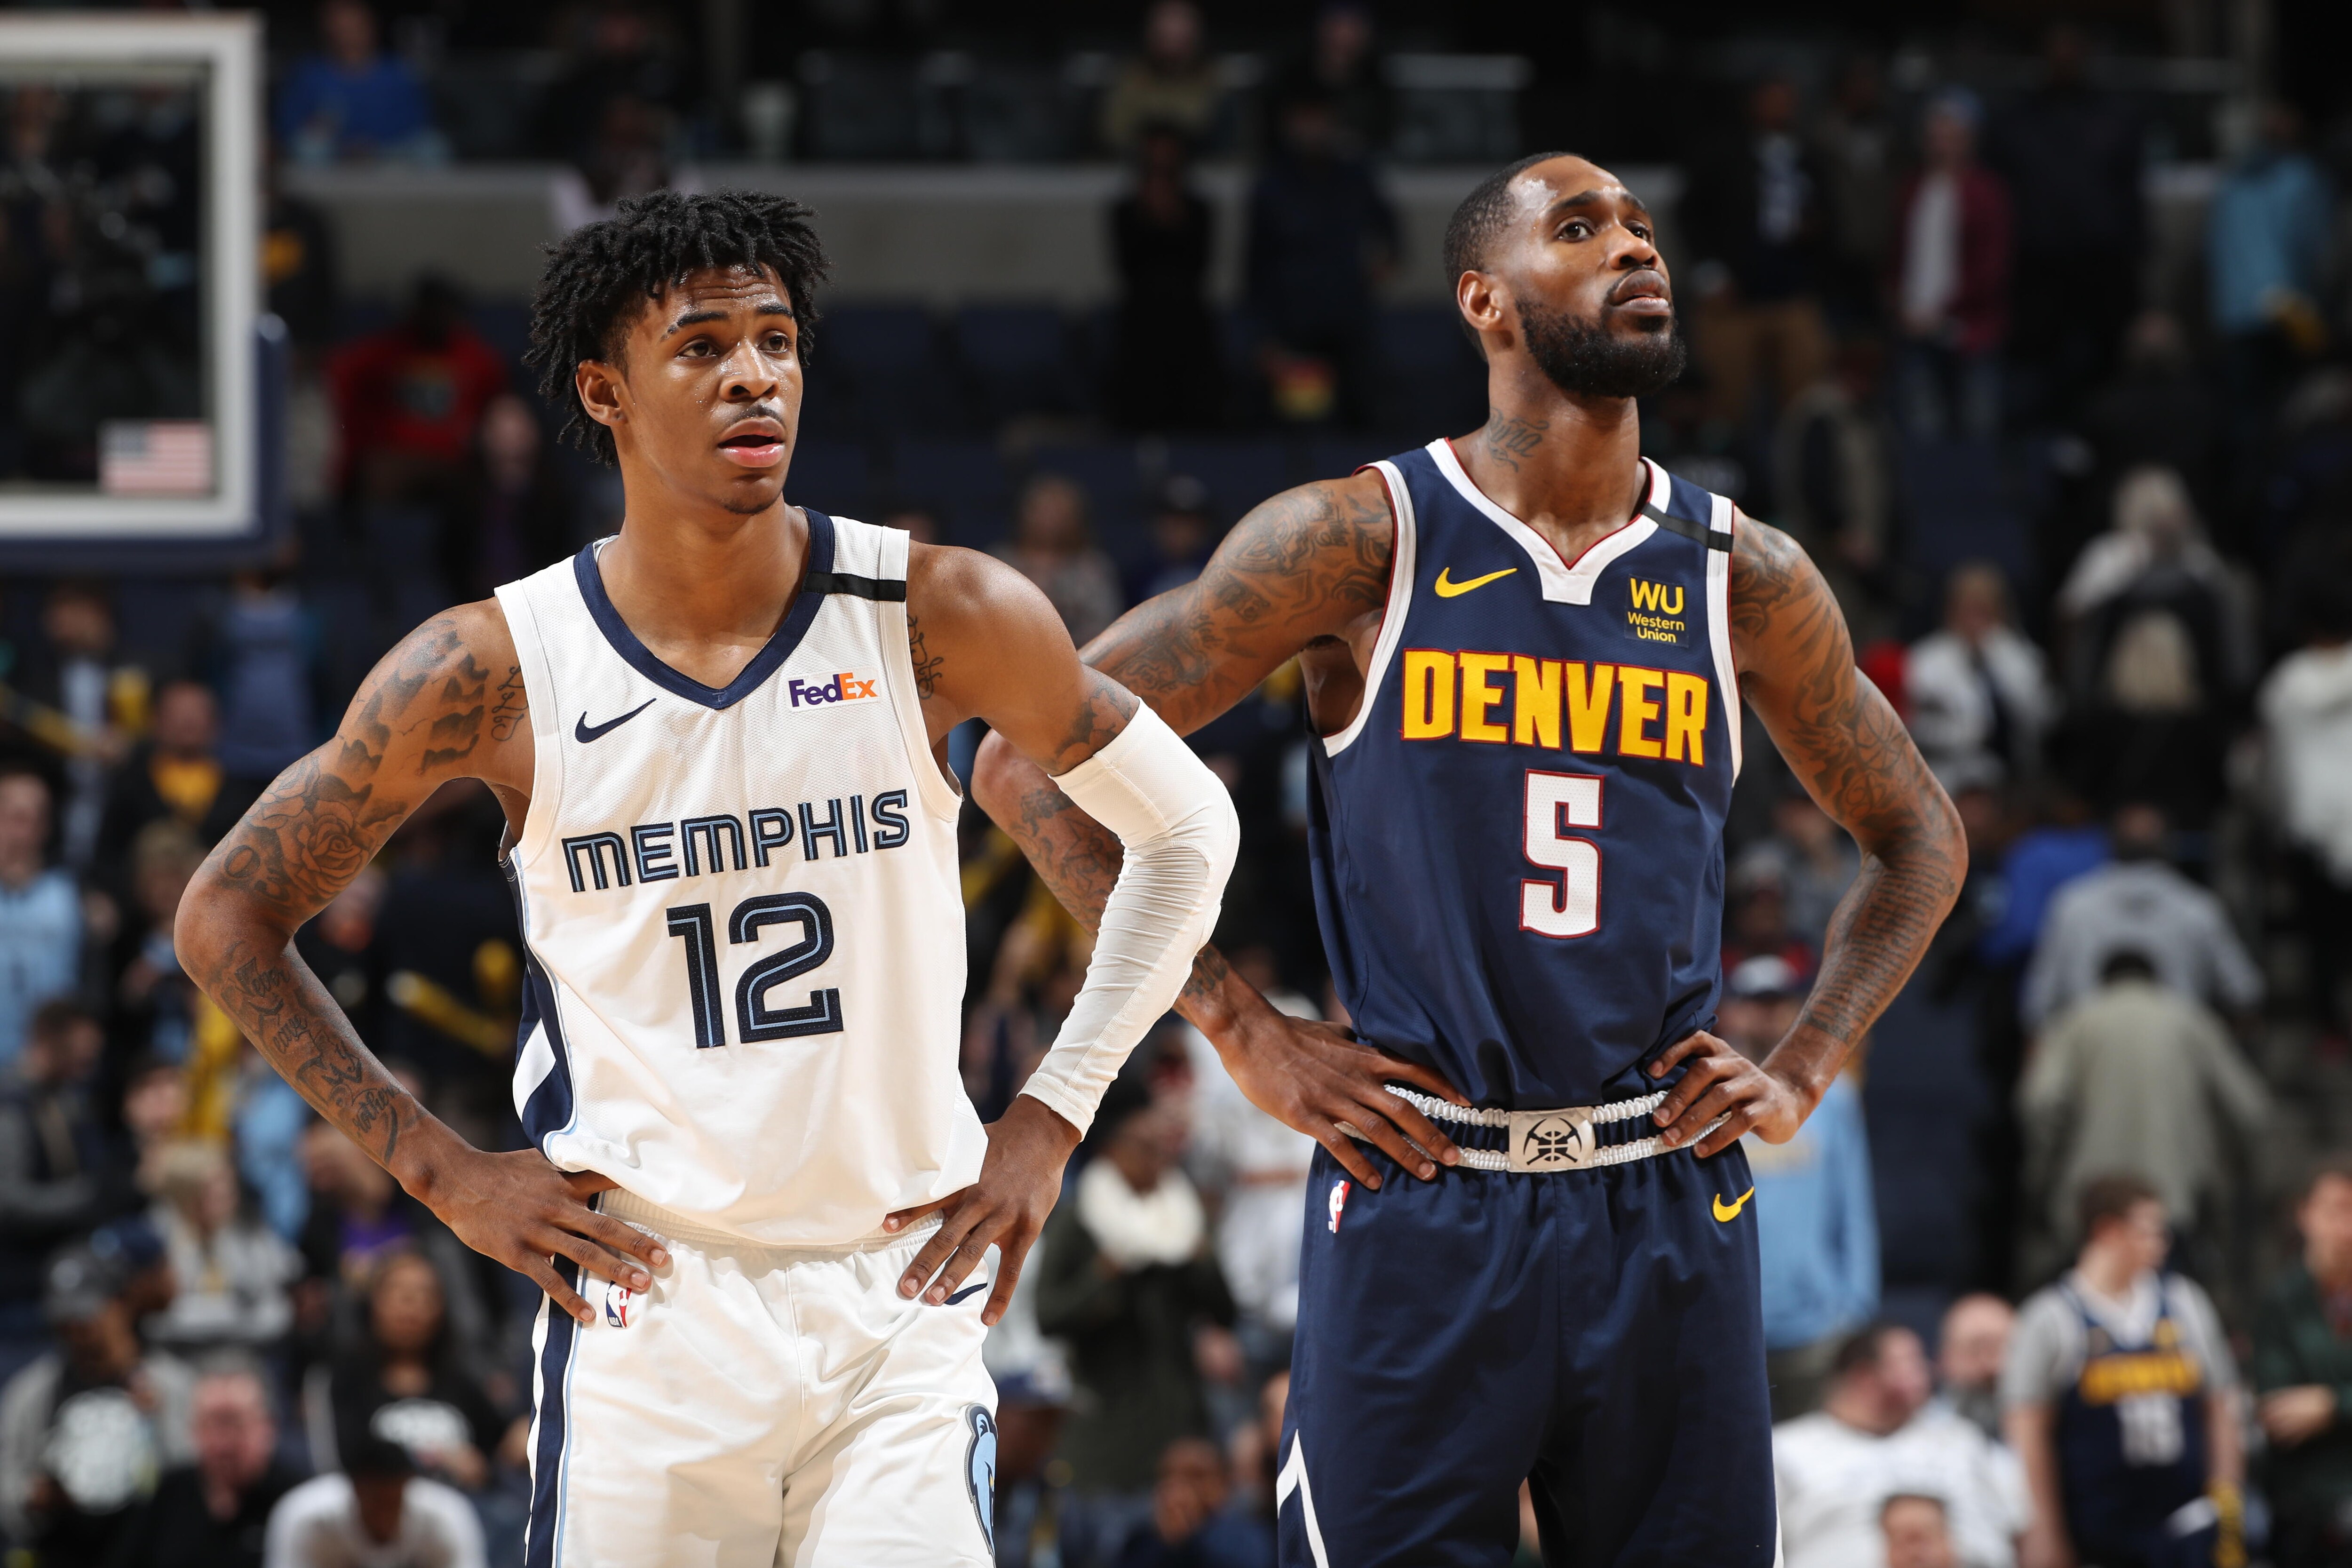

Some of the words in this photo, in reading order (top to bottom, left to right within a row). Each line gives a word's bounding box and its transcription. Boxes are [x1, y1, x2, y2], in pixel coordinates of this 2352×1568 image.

[1630, 578, 1684, 615] WU
[1628, 611, 1685, 631] Western
[1637, 627, 1677, 643] Union
[788, 672, 878, 708] FedEx
[1399, 647, 1709, 768] DENVER
[561, 789, 909, 893] MEMPHIS
[1519, 768, 1605, 939] 5
[667, 892, 843, 1049] 12
[609, 1317, 620, 1326] NBA
